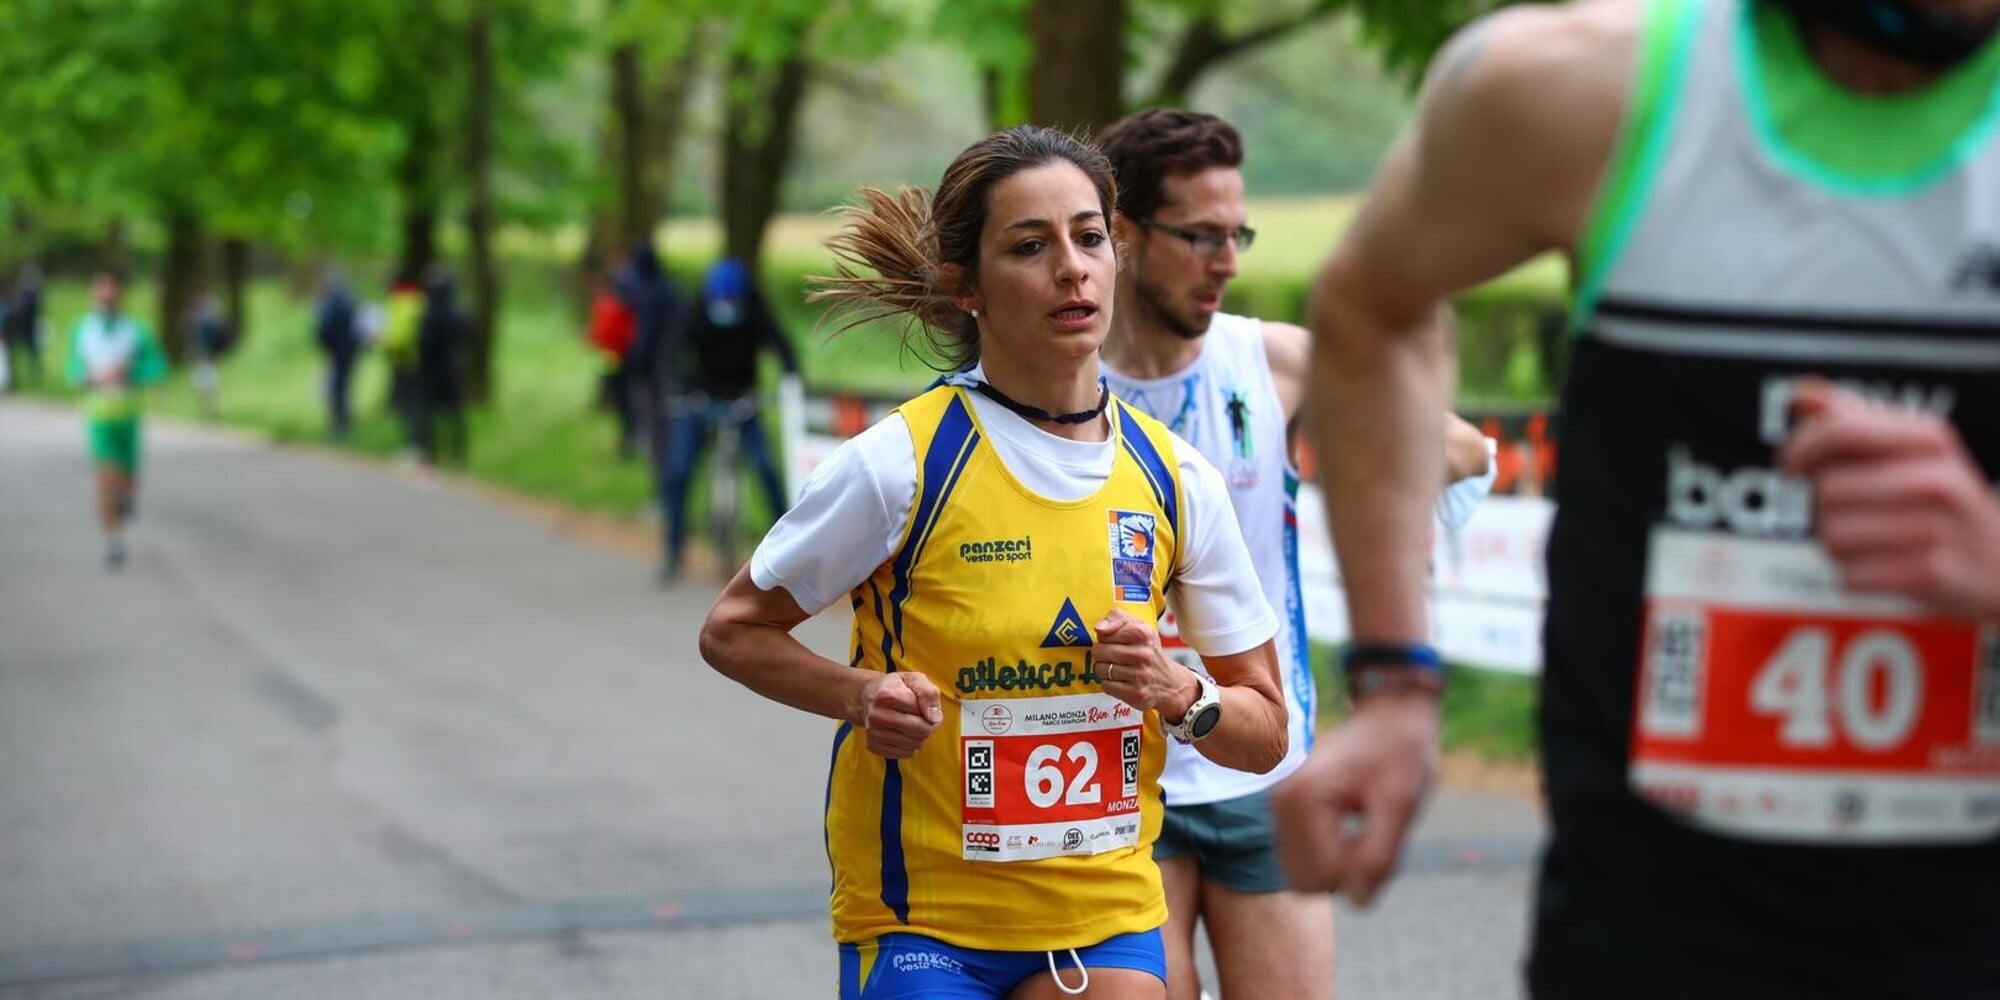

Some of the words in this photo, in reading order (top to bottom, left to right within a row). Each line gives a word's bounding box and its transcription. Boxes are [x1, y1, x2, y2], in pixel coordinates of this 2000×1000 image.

[960, 535, 1031, 558] panzeri
[965, 553, 993, 563] veste
[995, 552, 1005, 561] lo
[1006, 551, 1032, 563] sport
[956, 657, 1075, 693] atletica
[1748, 626, 1925, 752] 40
[1025, 713, 1058, 722] MILANO
[1059, 710, 1087, 719] MONZA
[1088, 706, 1109, 723] Run
[1113, 703, 1131, 720] Free
[1024, 741, 1101, 808] 62
[966, 832, 1000, 847] coop
